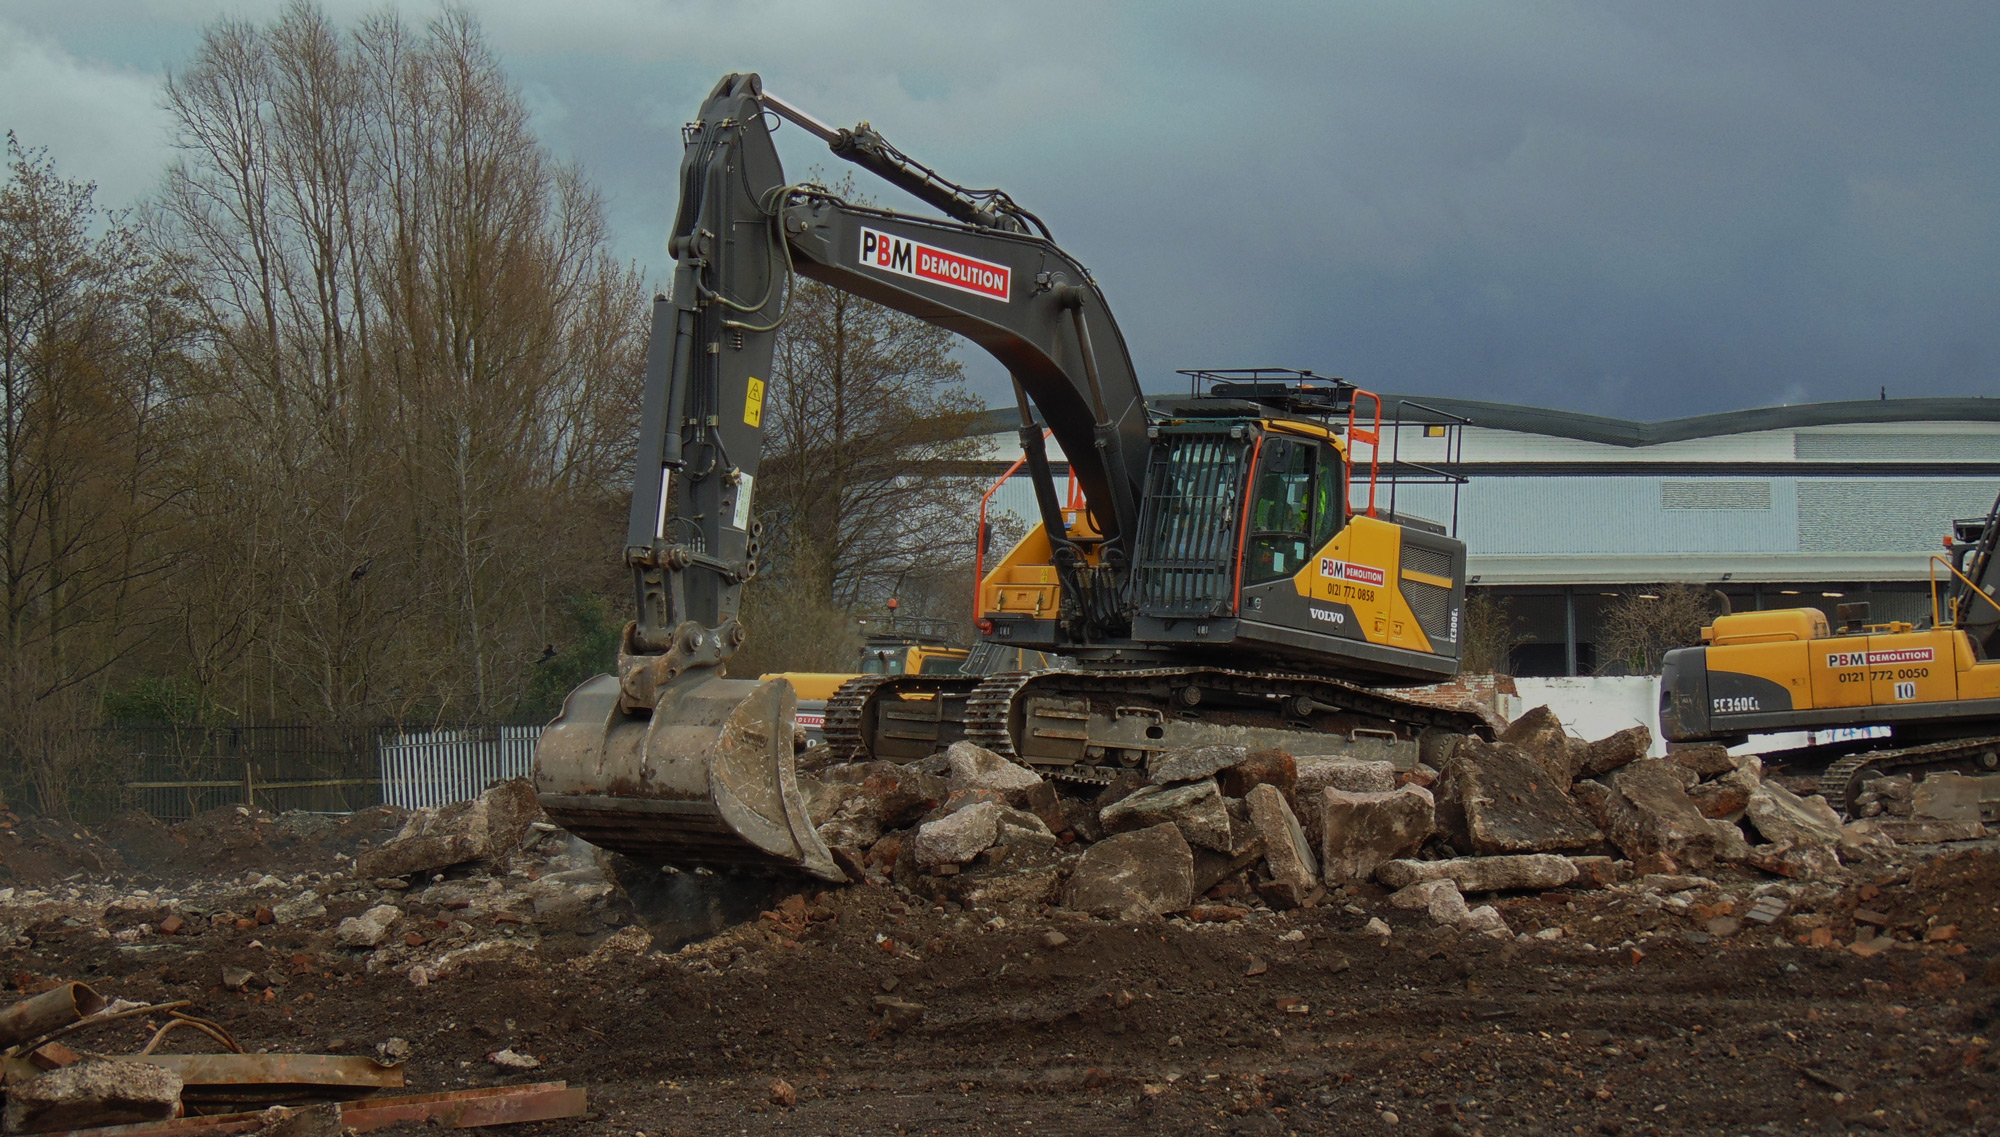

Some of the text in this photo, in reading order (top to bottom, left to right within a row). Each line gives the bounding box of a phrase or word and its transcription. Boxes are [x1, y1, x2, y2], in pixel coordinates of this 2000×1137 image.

[863, 230, 1004, 291] PBM DEMOLITION
[1322, 559, 1382, 582] PBM DEMOLITION
[1328, 583, 1375, 602] 0121 772 0858
[1309, 607, 1344, 624] VOLVO
[1828, 651, 1929, 667] PBM DEMOLITION
[1839, 667, 1929, 683] 0121 772 0050
[1896, 683, 1914, 699] 10
